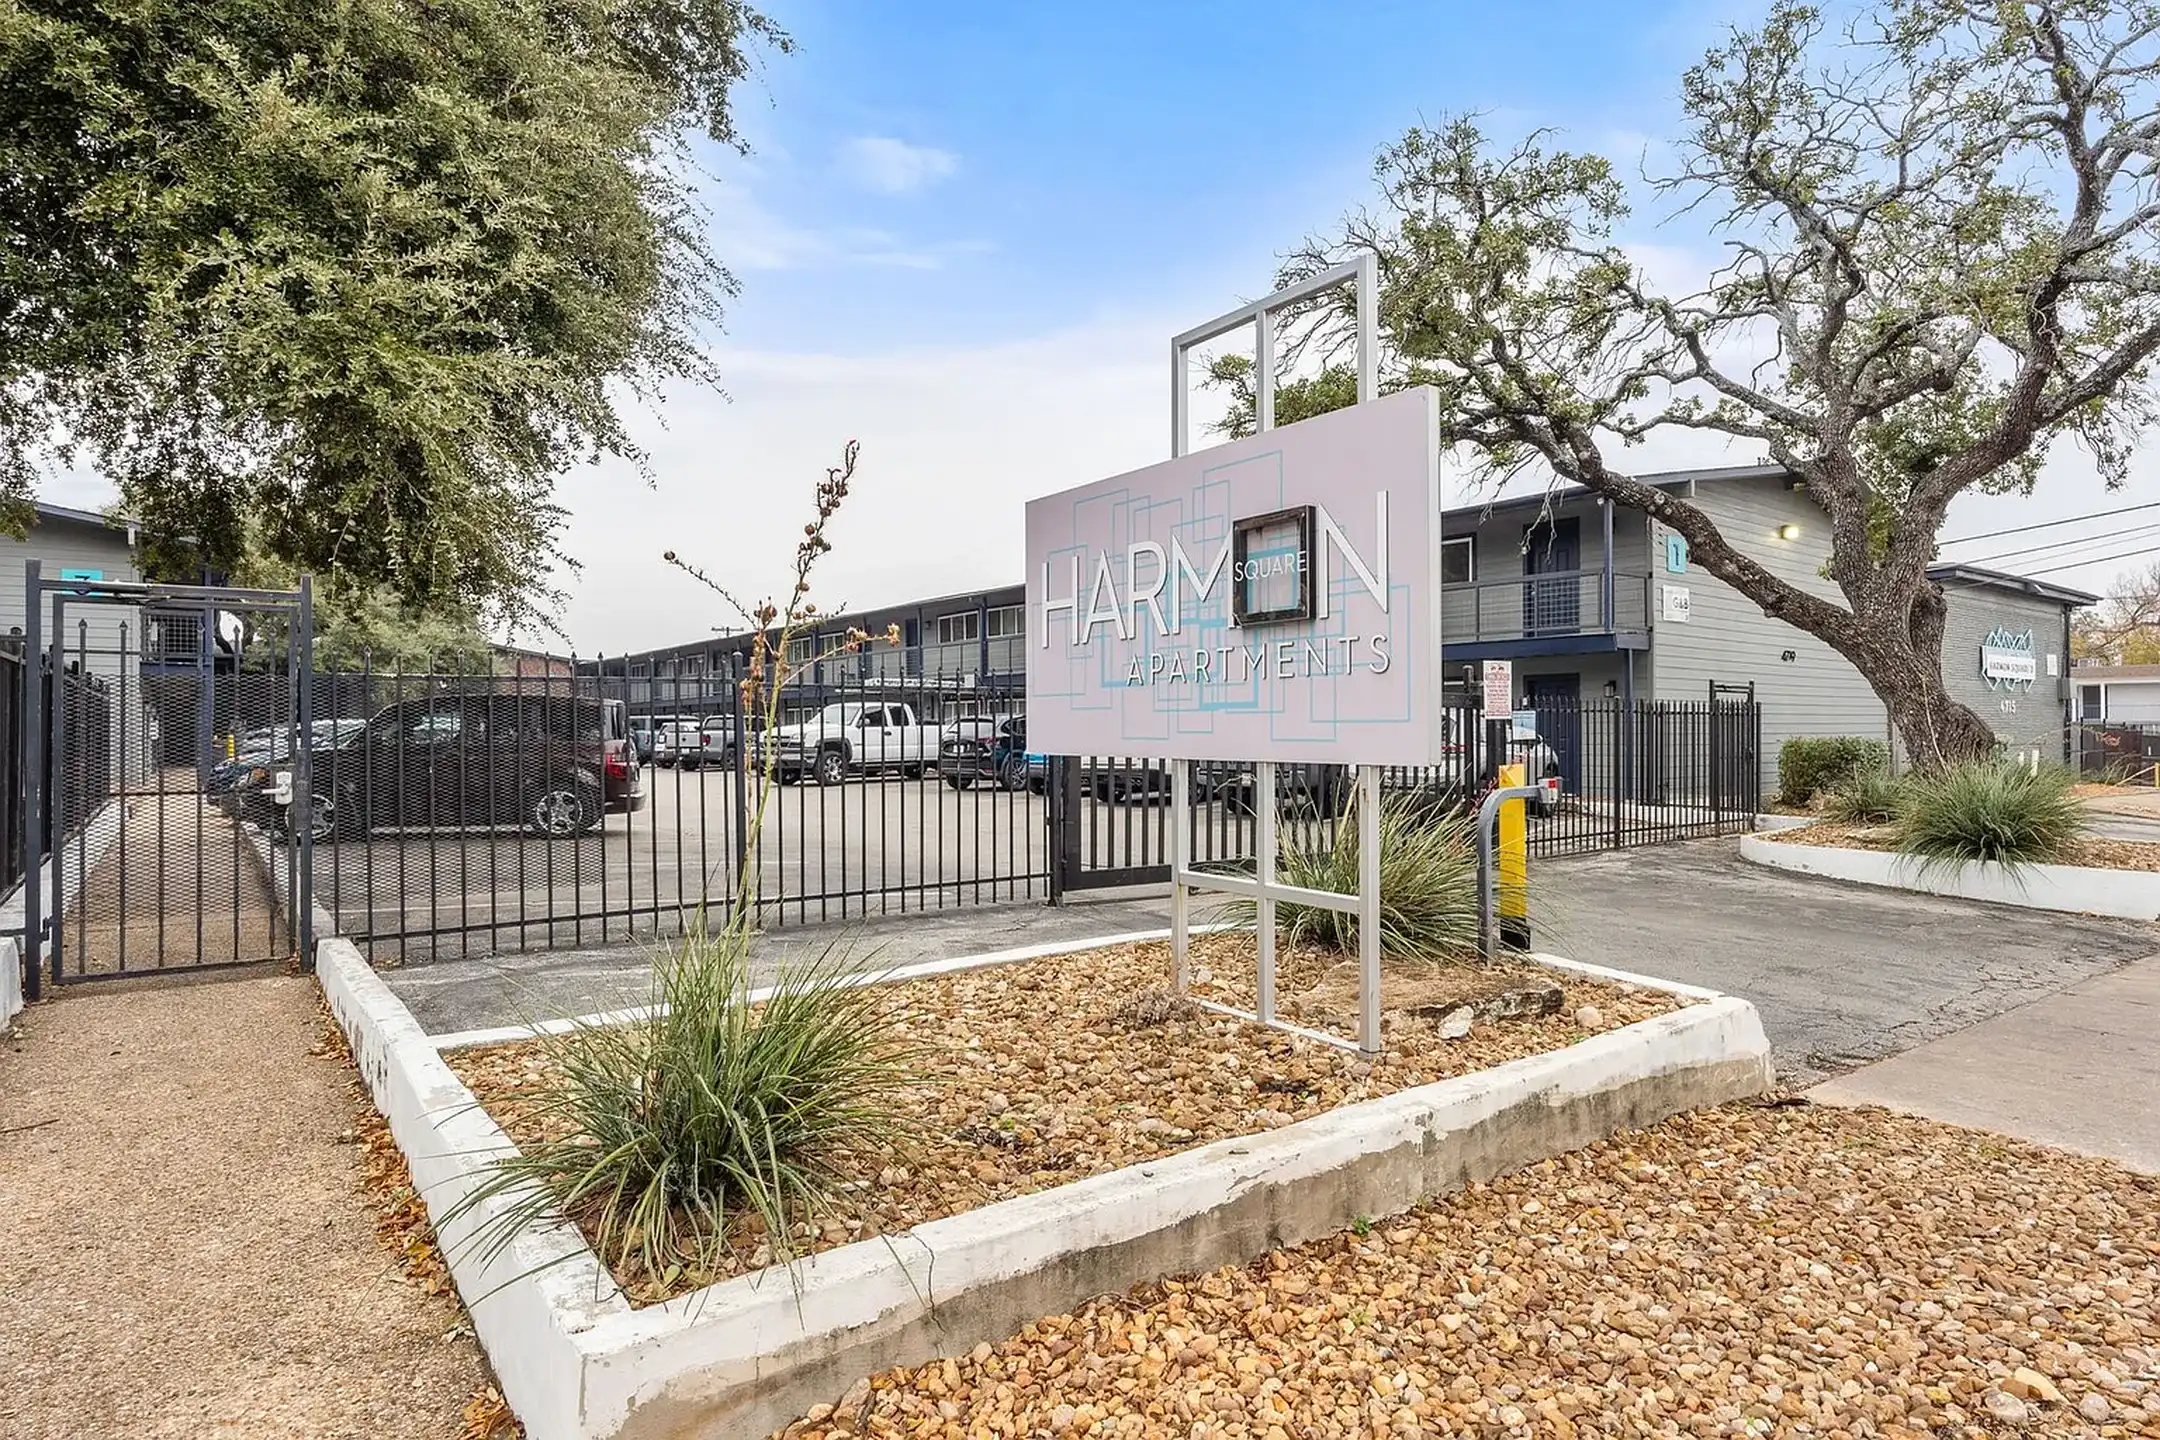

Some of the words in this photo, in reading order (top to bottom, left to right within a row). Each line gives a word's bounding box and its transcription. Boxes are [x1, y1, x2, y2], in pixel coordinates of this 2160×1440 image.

[1234, 550, 1308, 582] SQUARE
[1672, 543, 1680, 566] 1
[1126, 634, 1391, 687] APARTMENTS
